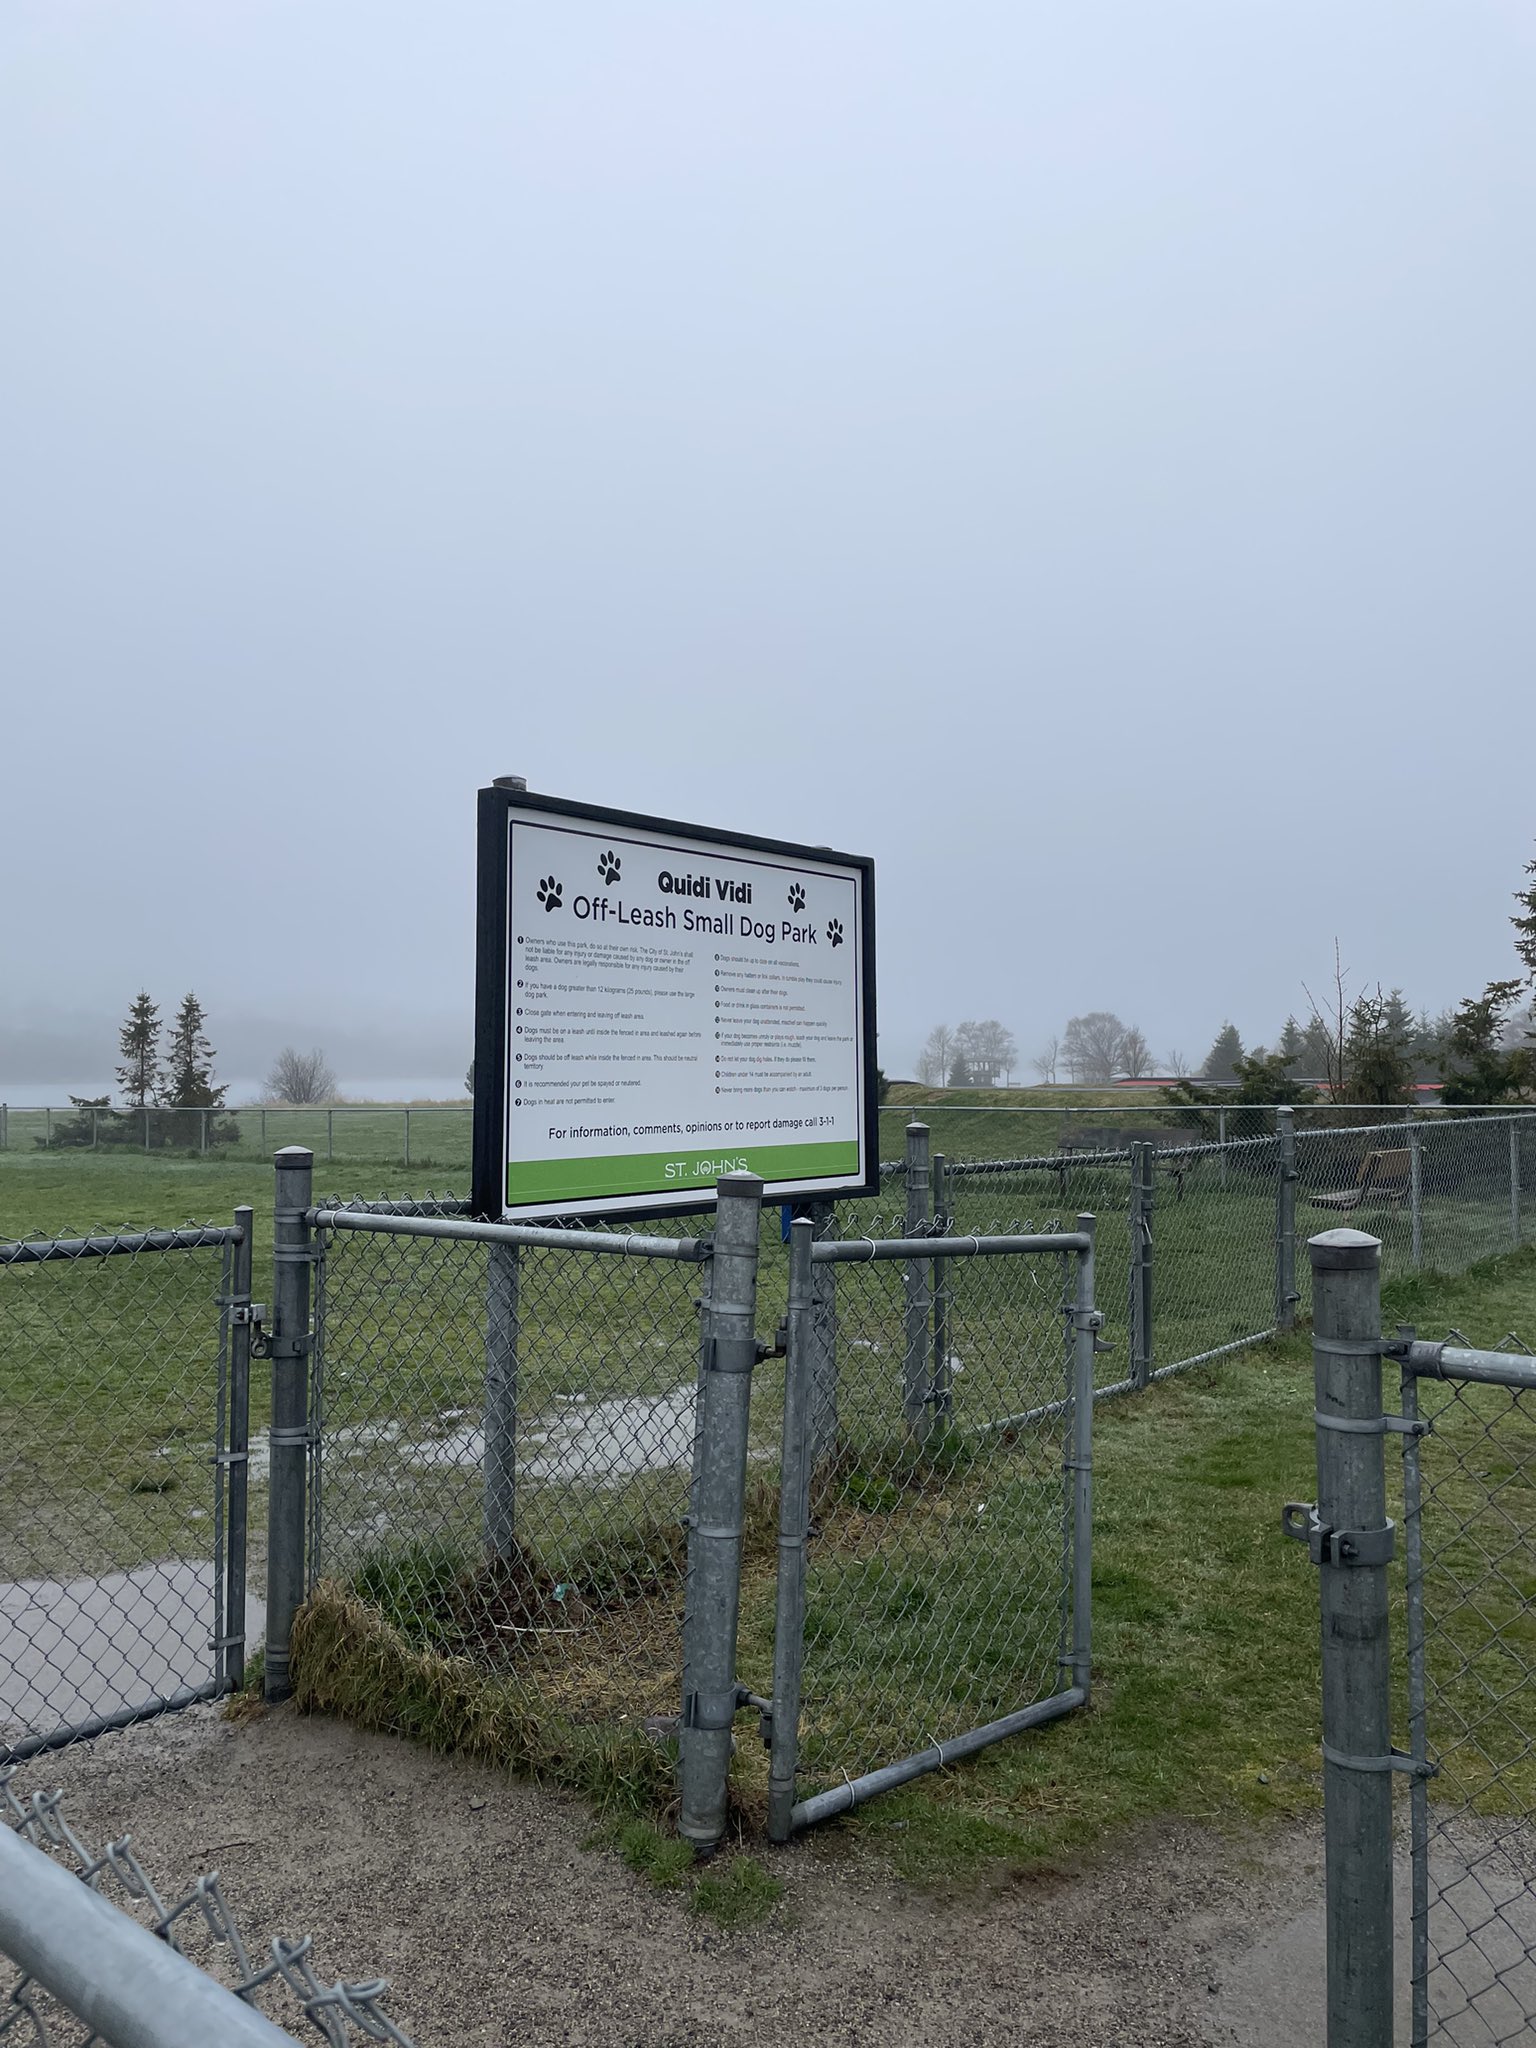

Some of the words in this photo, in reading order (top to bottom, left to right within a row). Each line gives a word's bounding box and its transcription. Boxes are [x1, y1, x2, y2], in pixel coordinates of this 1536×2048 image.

[657, 871, 710, 898] Quidi
[715, 880, 751, 904] Vidi
[573, 896, 676, 929] Off-Leash
[683, 910, 733, 935] Small
[740, 917, 775, 943] Dog
[781, 922, 817, 944] Park
[548, 1128, 566, 1139] For
[569, 1125, 630, 1138] information,
[633, 1123, 682, 1135] comments,
[685, 1121, 721, 1134] opinions
[735, 1120, 743, 1130] to
[746, 1119, 770, 1132] report
[772, 1118, 802, 1130] damage
[804, 1117, 816, 1126] call
[819, 1116, 834, 1126] 3-1-1
[664, 1162, 687, 1178] ST.
[692, 1156, 748, 1176] JOHN'S
